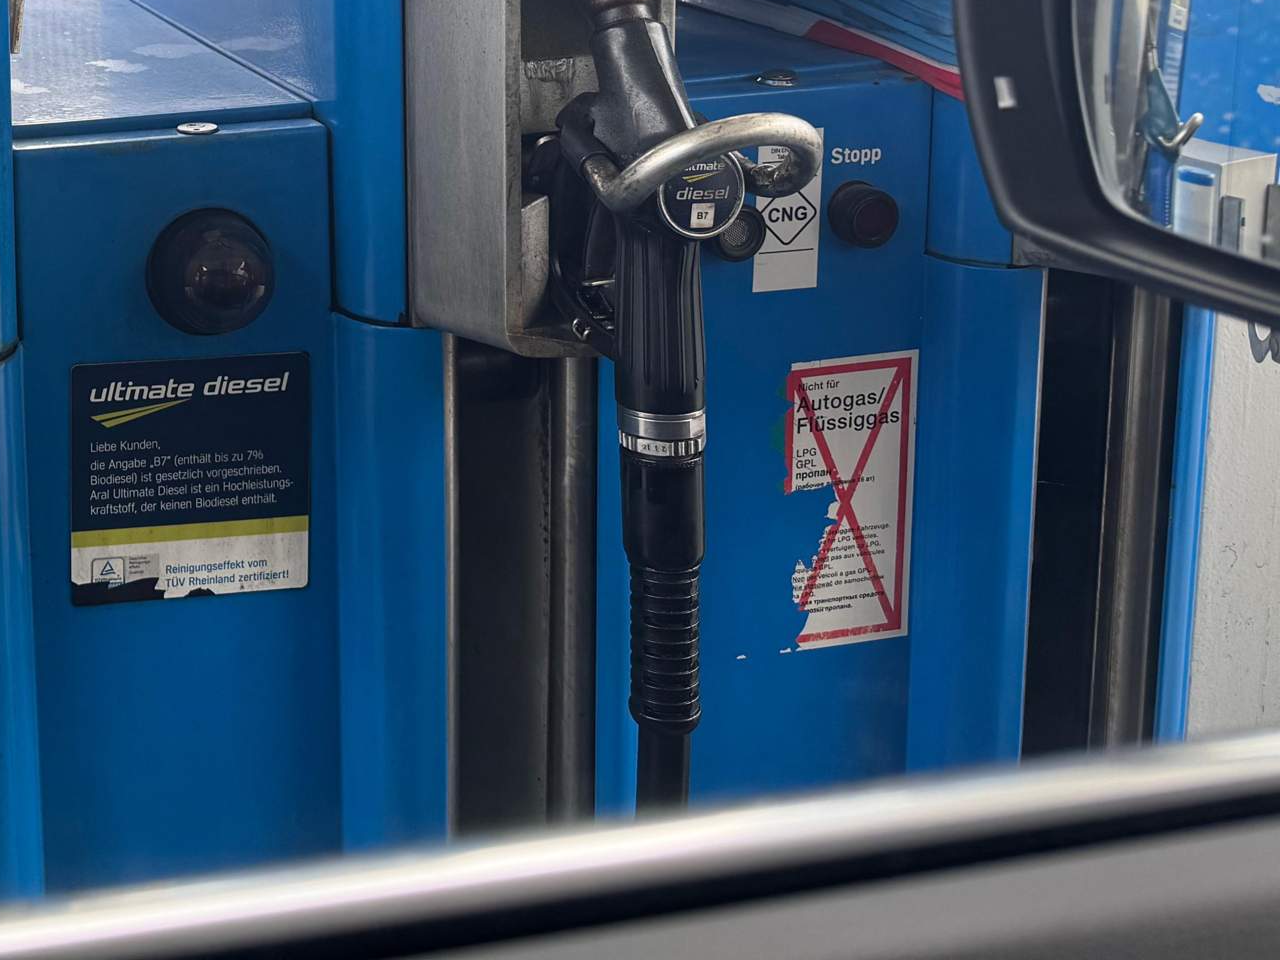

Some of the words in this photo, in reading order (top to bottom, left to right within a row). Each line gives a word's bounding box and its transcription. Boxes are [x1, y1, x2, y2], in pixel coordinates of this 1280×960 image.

[830, 147, 882, 166] Stopp
[676, 185, 730, 200] diesel
[697, 212, 709, 220] B7
[767, 205, 808, 223] CNG
[89, 377, 195, 403] ultimate
[203, 371, 291, 397] diesel
[798, 380, 824, 392] Nicht
[827, 379, 840, 390] für
[796, 386, 886, 414] Autogas/
[796, 410, 901, 435] Flüssiggas
[90, 442, 117, 453] Liebe
[120, 439, 161, 451] Kunden,
[796, 447, 817, 458] LPG
[90, 460, 106, 471] die
[108, 458, 147, 471] Angabe
[174, 453, 212, 468] (enthält
[214, 452, 229, 463] bis
[231, 453, 244, 462] zu
[795, 459, 817, 469] GPL
[90, 472, 138, 486] Biodiesel)
[140, 472, 153, 482] ist
[155, 468, 204, 484] gesetzlich
[206, 464, 282, 480] vorgeschrieben.
[89, 489, 110, 500] Aral
[113, 486, 155, 499] Ultimate
[157, 483, 188, 496] Diesel
[190, 483, 202, 494] ist
[204, 481, 220, 493] ein
[223, 478, 294, 492] Hochleistungs-
[90, 502, 138, 515] kraftstoff,
[140, 501, 157, 512] der
[160, 499, 192, 511] keinen
[195, 495, 239, 508] Biodiesel
[241, 492, 278, 505] enthält.
[165, 559, 245, 576] Reinigungseffekt
[247, 558, 268, 569] vom
[165, 576, 186, 589] TÜV
[188, 571, 236, 586] Rheinland
[238, 569, 290, 583] zertifiziert!
